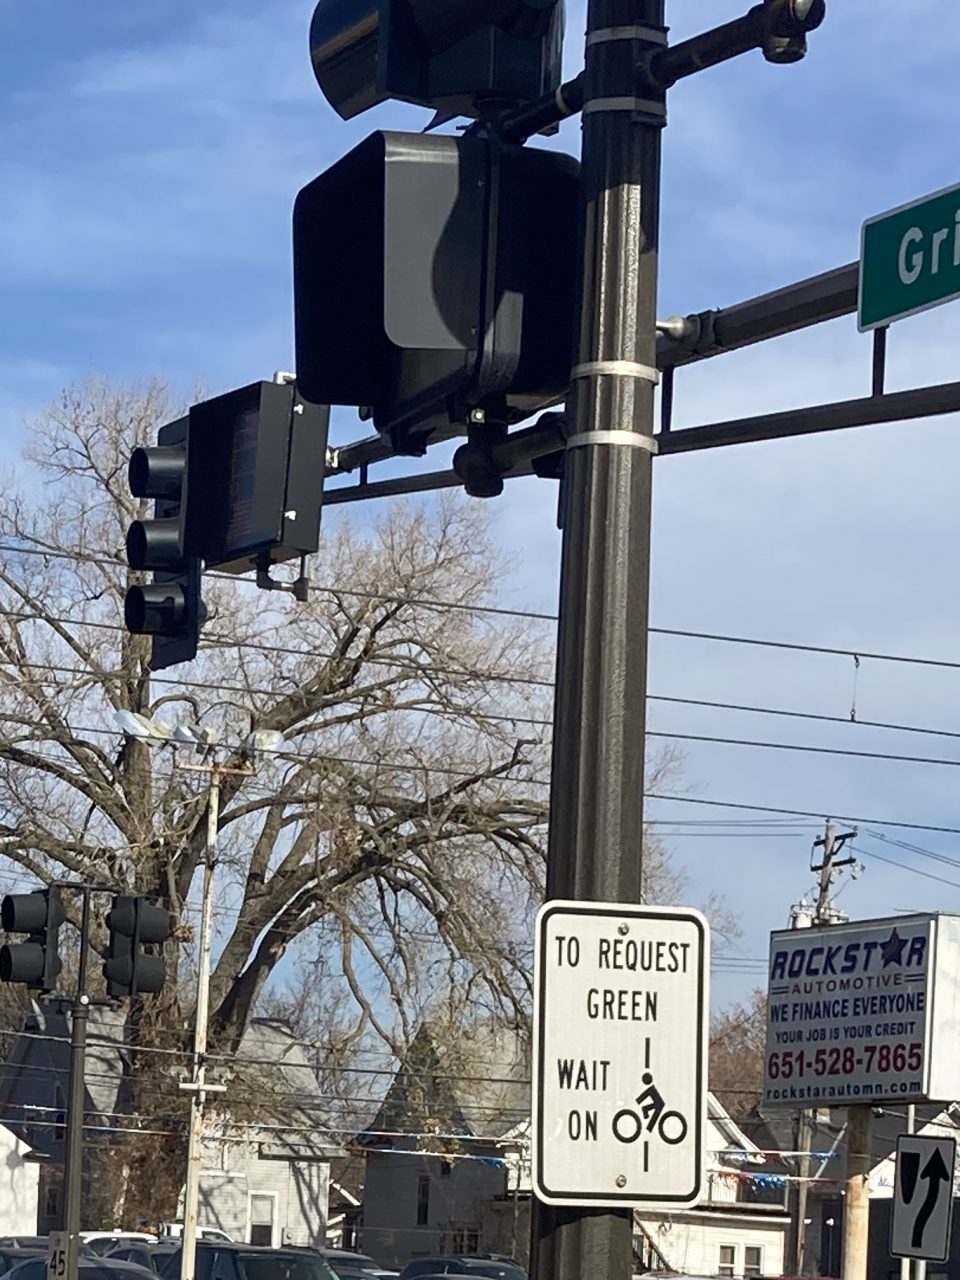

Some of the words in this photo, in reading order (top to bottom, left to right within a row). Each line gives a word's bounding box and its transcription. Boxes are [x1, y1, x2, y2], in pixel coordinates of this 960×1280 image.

[555, 936, 580, 967] TO
[598, 939, 690, 973] REQUEST
[792, 973, 903, 995] AUTOMOTIVE
[587, 988, 658, 1022] GREEN
[770, 1003, 789, 1023] WE
[792, 999, 849, 1021] FINANCE
[852, 992, 925, 1017] EVERYONE
[775, 1029, 803, 1044] YOUR
[806, 1028, 826, 1042] JOB
[829, 1026, 840, 1040] IS
[843, 1024, 872, 1039] YOUR
[875, 1021, 916, 1036] CREDIT
[557, 1058, 611, 1091] WAIT
[768, 1043, 922, 1079] 651-528-7865
[766, 1080, 922, 1100] rockstarautomn.com
[568, 1110, 598, 1141] ON
[50, 1250, 66, 1276] 45
